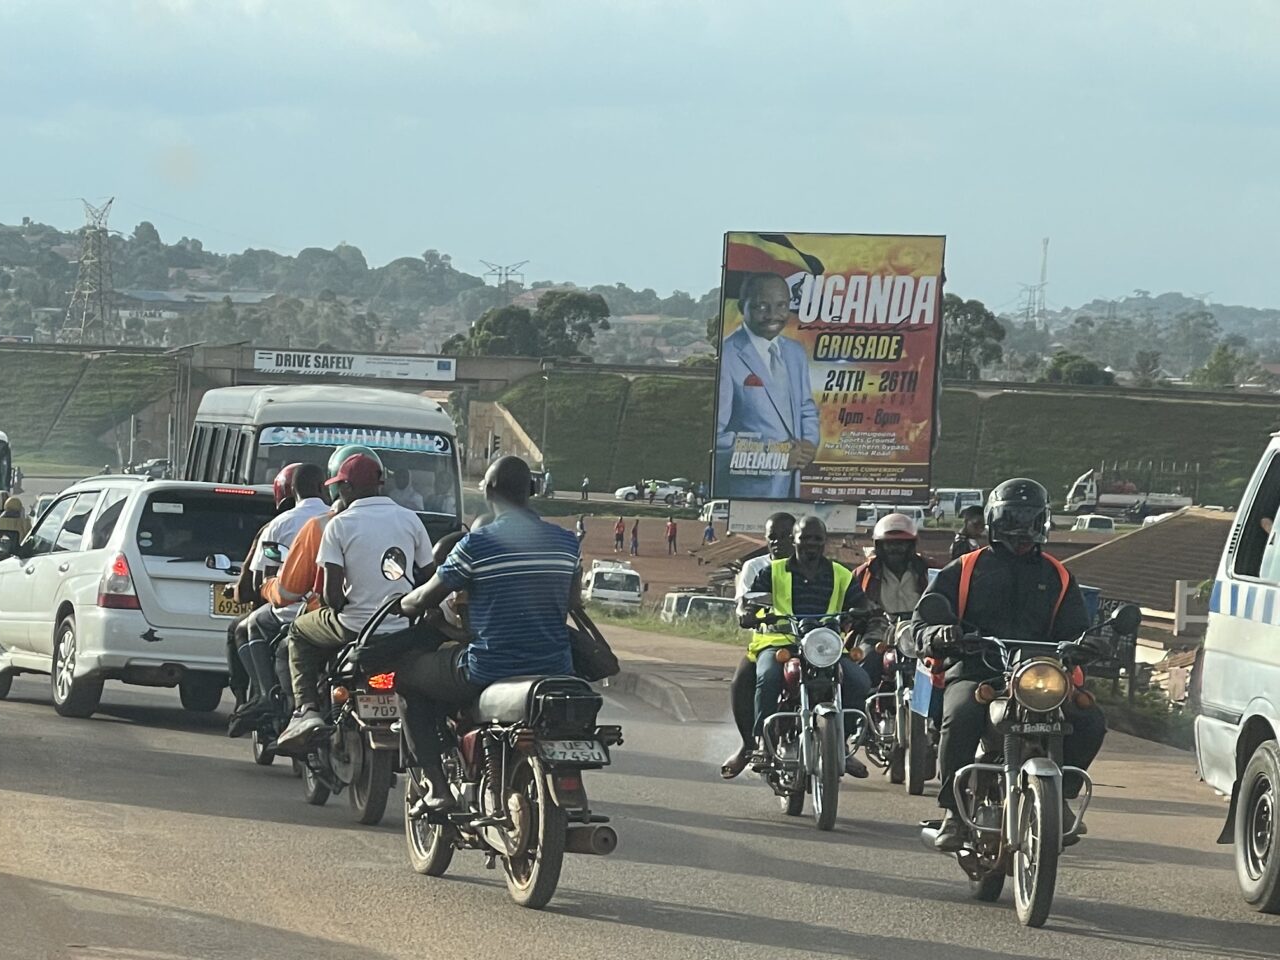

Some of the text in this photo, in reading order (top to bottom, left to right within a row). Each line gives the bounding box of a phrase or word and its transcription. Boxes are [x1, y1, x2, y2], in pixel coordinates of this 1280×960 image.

[798, 274, 938, 325] UGANDA
[817, 335, 901, 360] CRUSADE
[275, 353, 311, 369] DRIVE
[313, 355, 355, 370] SAFELY
[824, 370, 866, 391] 24TH
[878, 371, 919, 393] 26TH
[822, 393, 868, 404] MARCH
[838, 408, 864, 426] 4pm
[874, 408, 901, 427] 8pm
[730, 453, 790, 470] ADELAKUN
